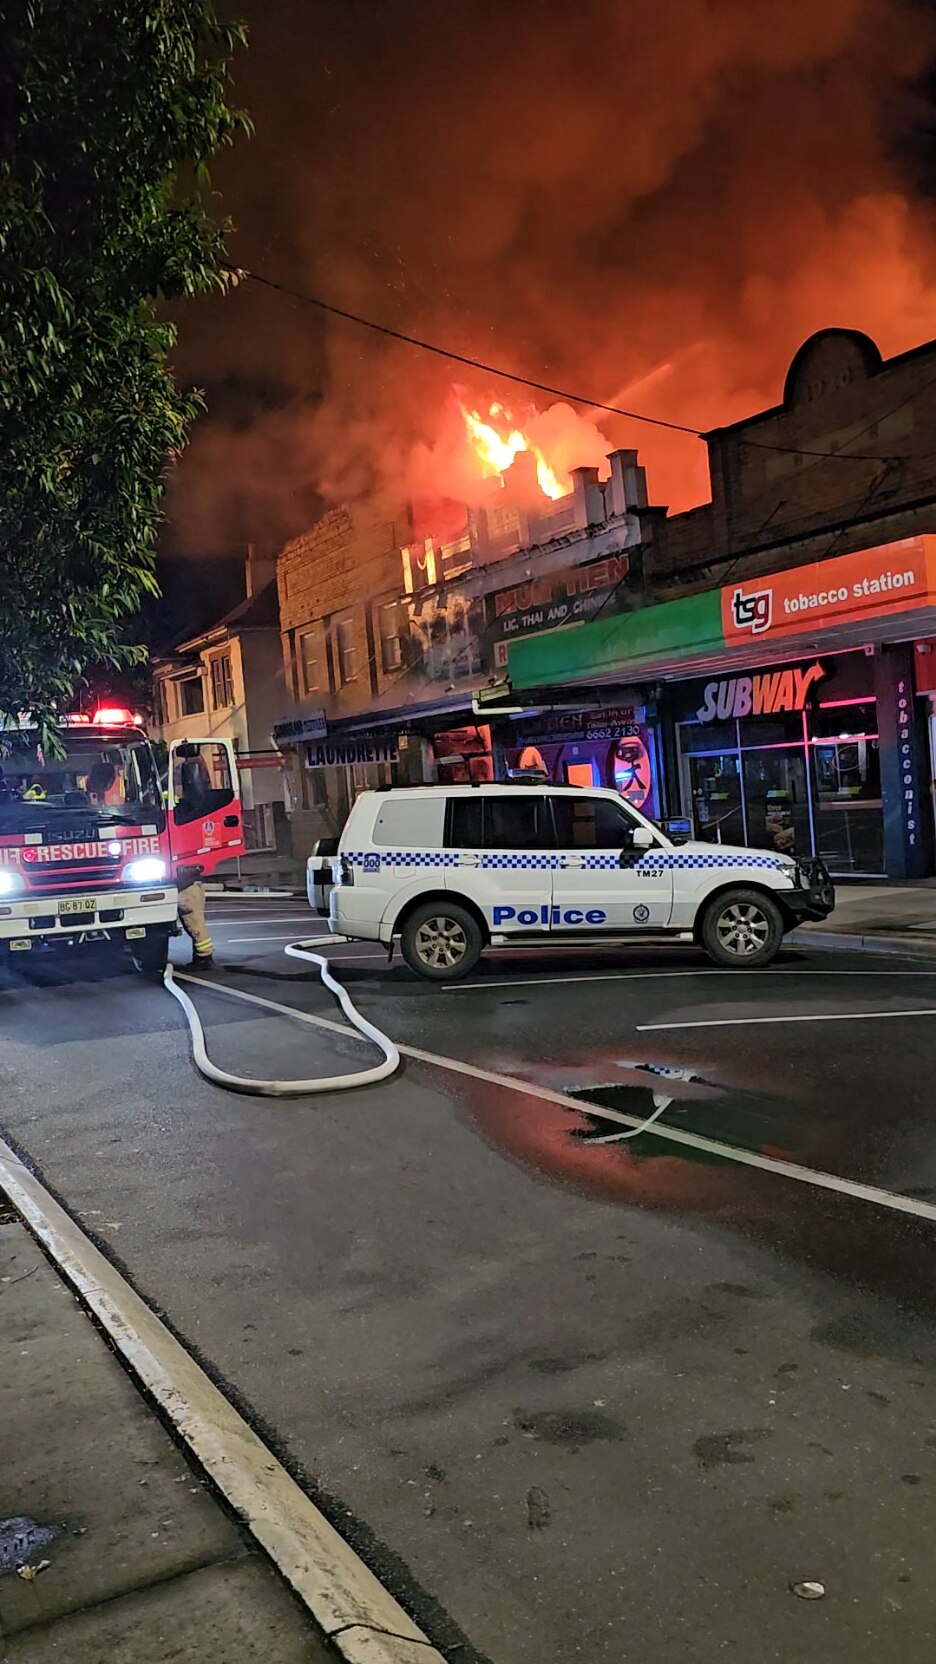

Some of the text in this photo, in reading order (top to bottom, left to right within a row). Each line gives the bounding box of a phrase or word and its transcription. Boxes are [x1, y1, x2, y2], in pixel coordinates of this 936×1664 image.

[731, 570, 916, 634] tsg tobacco station
[503, 618, 519, 632] LIC.
[522, 611, 544, 627] THAI
[547, 605, 568, 620] AND
[696, 660, 826, 724] SUBWAY
[586, 728, 612, 740] 6662
[614, 725, 640, 738] 2130
[307, 745, 398, 767] LAUNDRETTE
[898, 681, 916, 846] tobacconist
[37, 837, 160, 863] RESCUE FIRE
[363, 859, 381, 868] 000
[636, 870, 664, 878] TM27
[493, 905, 606, 926] Police
